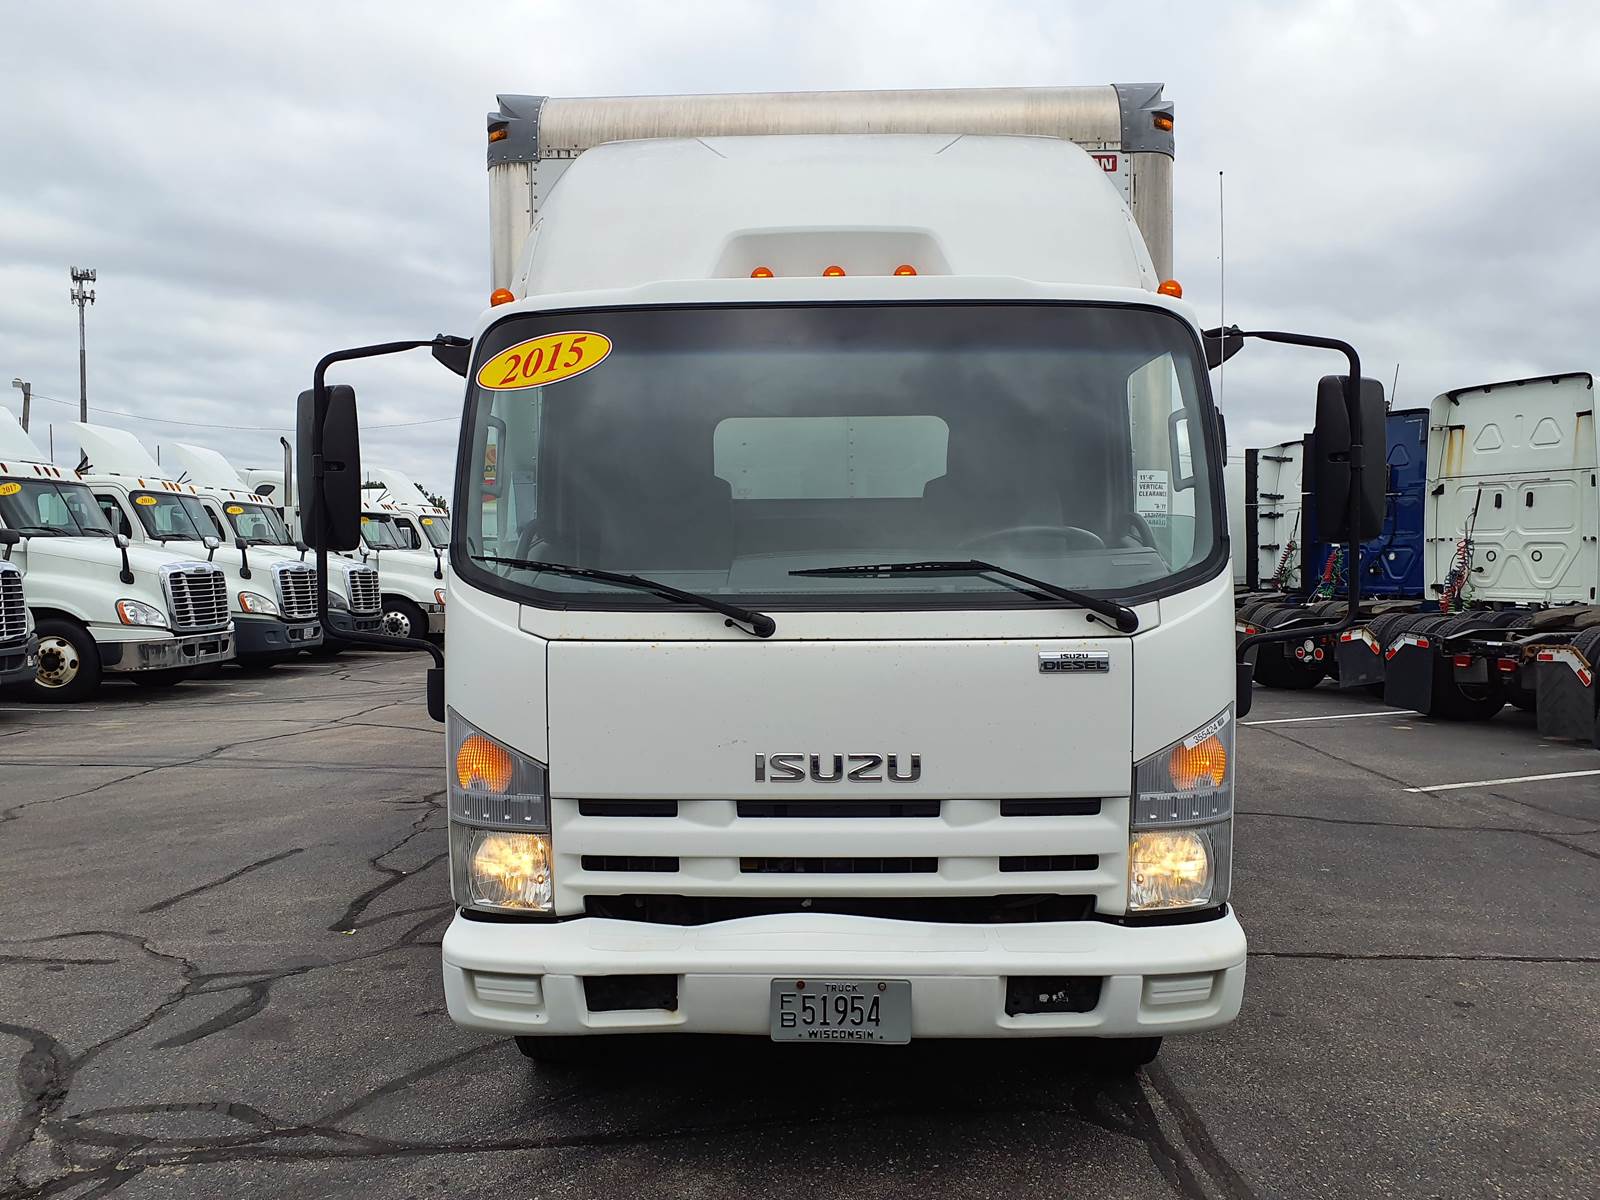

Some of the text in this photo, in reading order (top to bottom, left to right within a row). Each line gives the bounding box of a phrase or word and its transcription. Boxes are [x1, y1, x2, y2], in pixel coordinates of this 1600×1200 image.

[499, 336, 587, 386] 2015
[1042, 660, 1108, 671] DIESEL
[1193, 722, 1218, 744] 355424
[755, 752, 921, 782] ISUZU
[825, 984, 858, 992] TRUCK
[802, 994, 881, 1027] 51954
[808, 1029, 874, 1040] WISCONSIN
